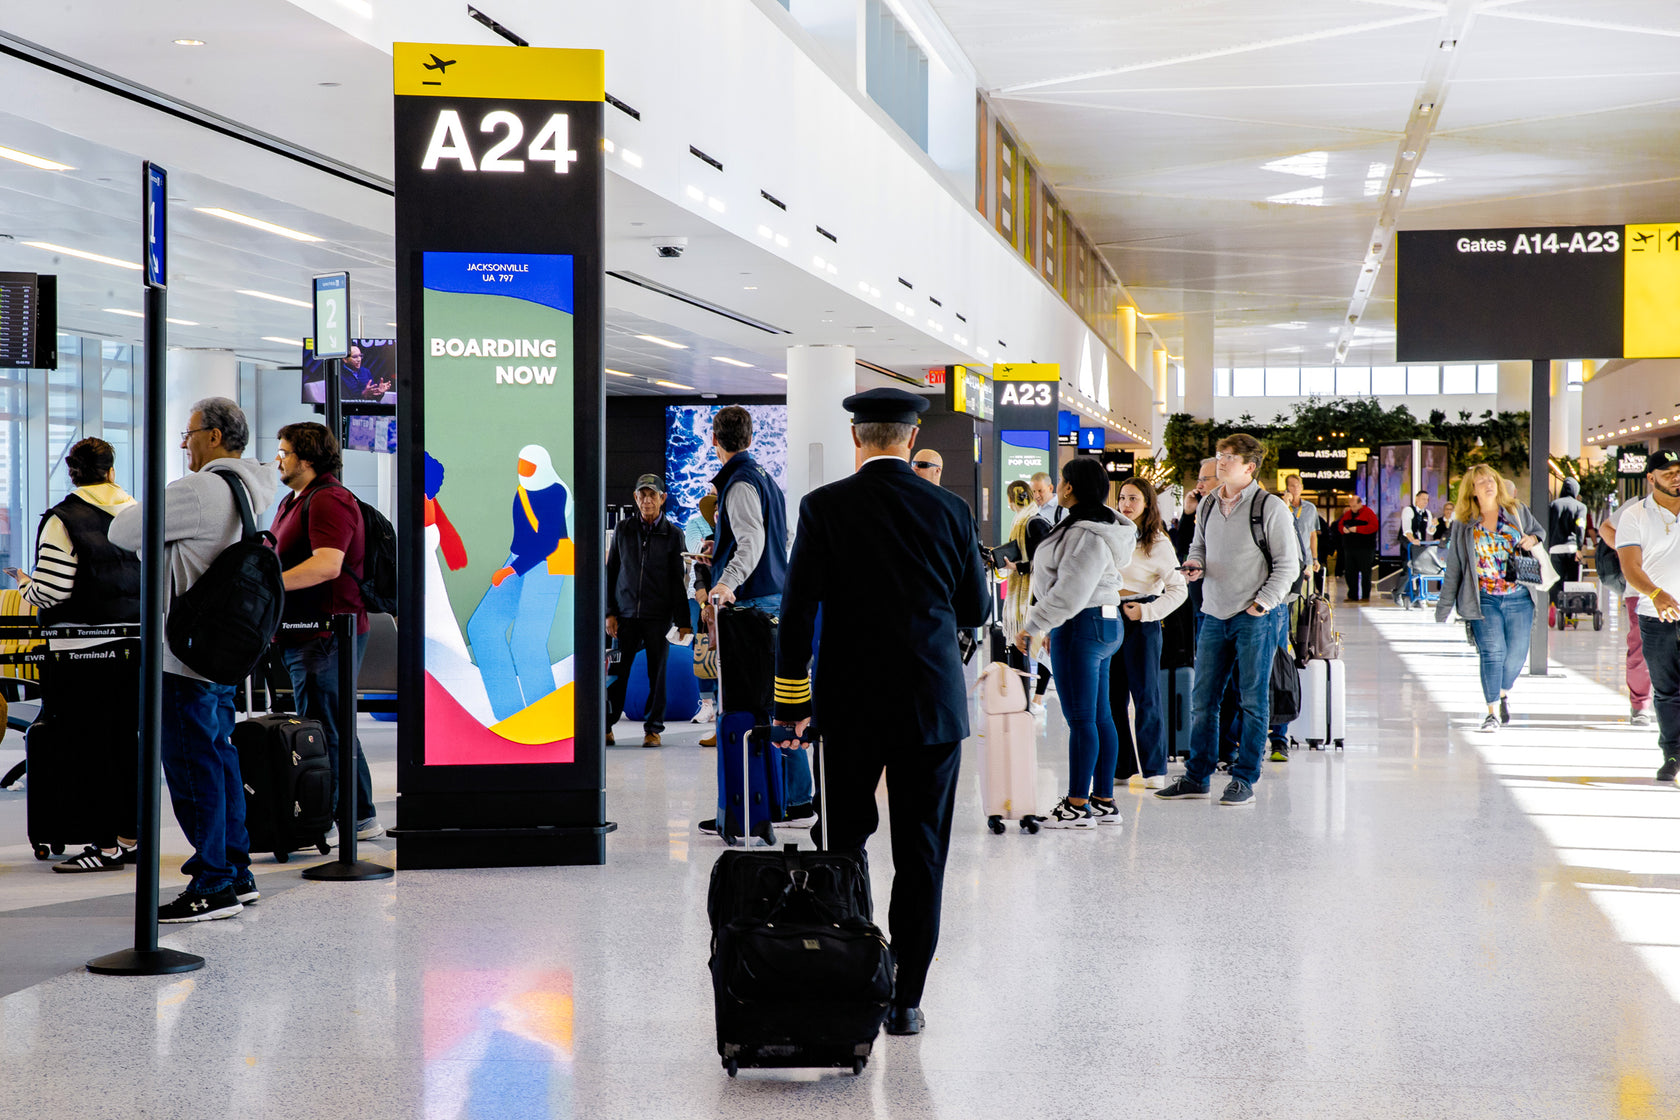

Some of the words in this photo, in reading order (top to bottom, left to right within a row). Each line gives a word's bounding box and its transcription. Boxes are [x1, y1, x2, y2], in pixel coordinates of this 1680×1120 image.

[421, 109, 578, 174] A24
[1457, 238, 1507, 253] Gates
[1512, 231, 1620, 254] A14-A23
[467, 263, 529, 273] JACKSONVILLE
[482, 274, 496, 282] UA
[499, 274, 514, 283] 797
[326, 298, 337, 329] 2
[430, 338, 557, 358] BOARDING
[495, 366, 558, 385] NOW
[1000, 383, 1052, 406] A23
[1297, 450, 1315, 458] Gates
[1315, 449, 1347, 459] A15-A18
[1300, 471, 1317, 479] Gates
[1317, 470, 1351, 479] A19-A22
[77, 629, 109, 637] Terminal
[109, 628, 116, 636] A
[24, 654, 45, 662] EWR
[69, 652, 108, 660] Terminal
[108, 651, 116, 659] A
